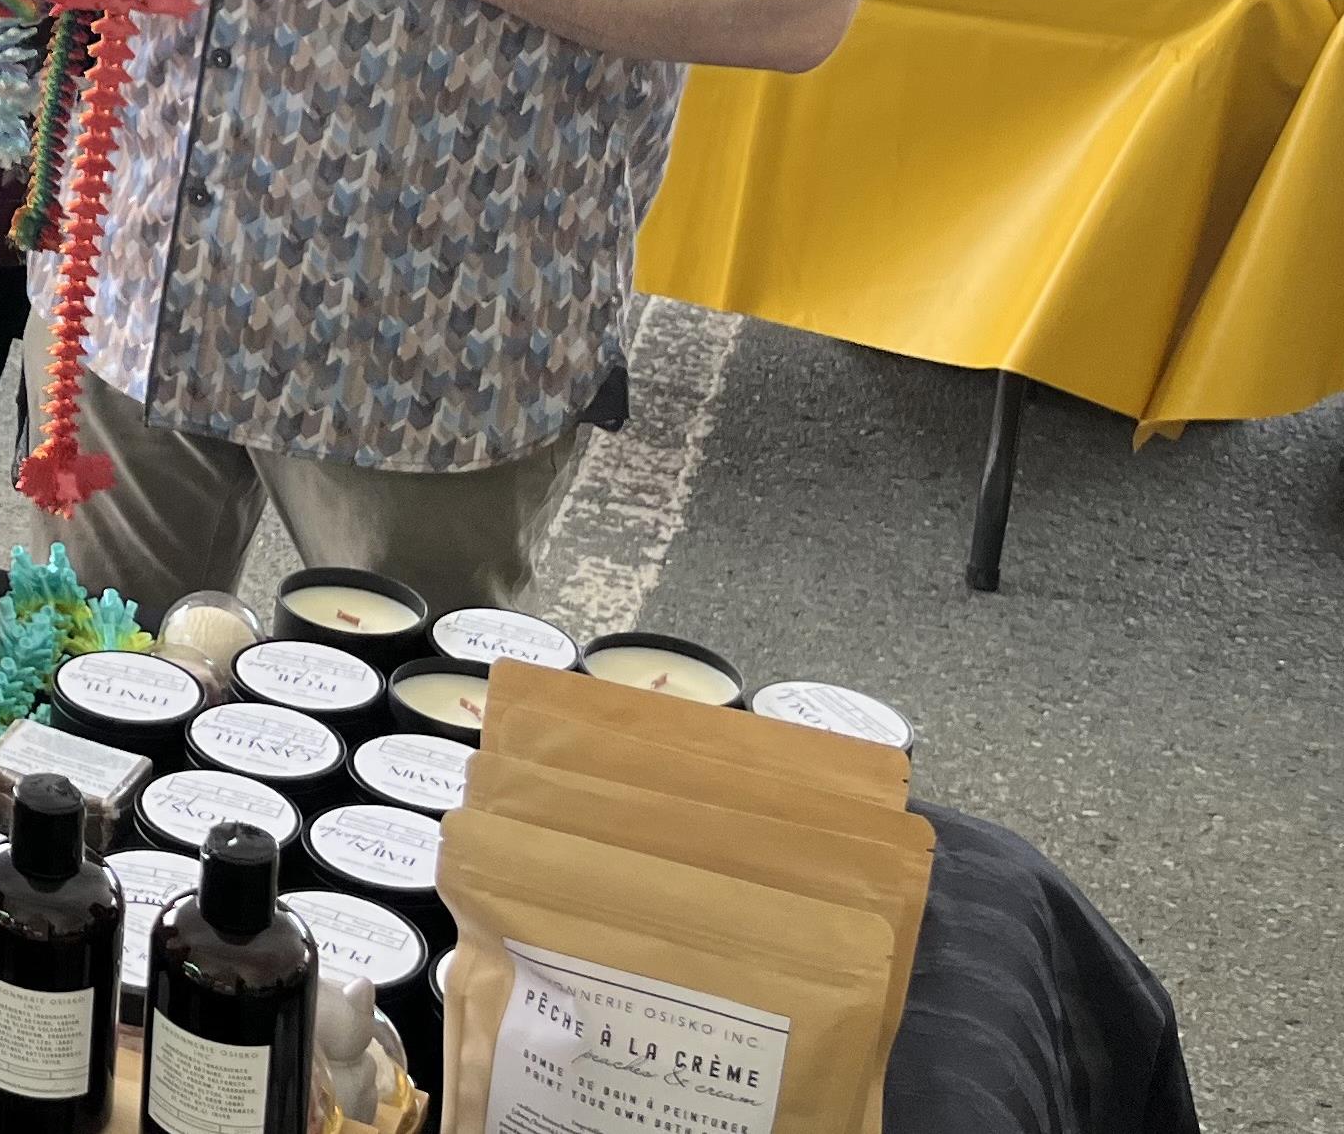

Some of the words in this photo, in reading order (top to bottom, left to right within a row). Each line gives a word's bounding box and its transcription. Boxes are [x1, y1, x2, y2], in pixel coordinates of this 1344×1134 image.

[644, 1007, 713, 1035] OSISKO
[524, 988, 584, 1039] PÊCHE
[600, 1023, 612, 1048] À
[629, 1037, 657, 1061] LA
[675, 1051, 759, 1089] CRÈME
[614, 1105, 645, 1124] OWN
